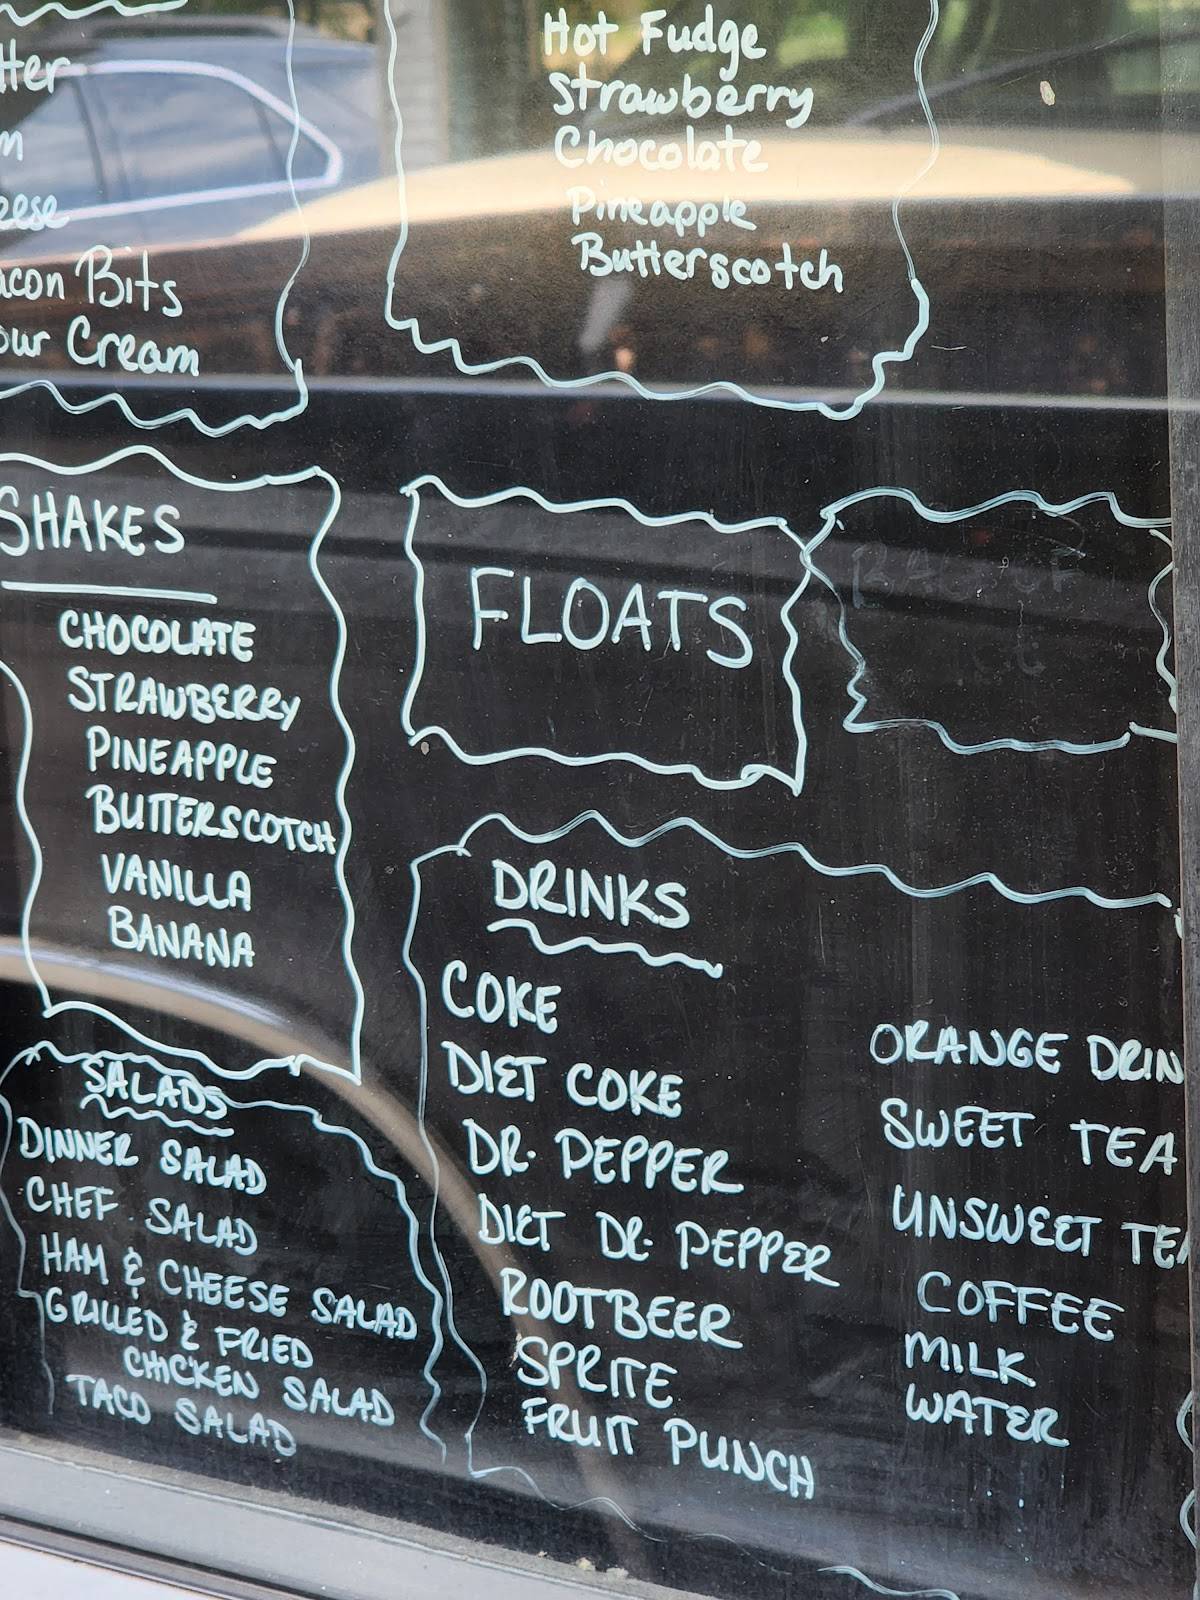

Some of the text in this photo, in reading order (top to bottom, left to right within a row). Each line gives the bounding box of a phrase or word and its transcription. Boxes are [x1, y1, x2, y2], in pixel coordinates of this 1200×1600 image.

[544, 4, 767, 81] Hot Fudge
[549, 62, 814, 129] Strawberry
[554, 124, 769, 173] Chocolate
[566, 184, 757, 237] Pineapple
[75, 244, 183, 318] Bits
[570, 232, 843, 293] Butterscotch
[67, 315, 200, 377] Cream
[0, 485, 186, 557] SHAKES
[59, 608, 256, 662] CHOCOLATE
[471, 567, 754, 669] FLOATS
[67, 665, 302, 733] STRAWBERRY
[86, 725, 278, 789] PINEAPPLE
[85, 783, 338, 856] BUTTERSCOTCH
[101, 853, 252, 912] VANILLA
[491, 859, 691, 929] DRINKS
[107, 904, 256, 968] BANANA
[441, 959, 562, 1034] COKE
[441, 1040, 683, 1119] DIET COKE
[870, 1020, 1070, 1075] ORANGE
[81, 1057, 229, 1121] SALADS
[16, 1116, 267, 1196] DINNER SALAD
[462, 1118, 744, 1195] DR. PEPPER
[881, 1097, 1179, 1177] SWEET TEA
[26, 1176, 258, 1256] CHEF SALAD
[477, 1192, 841, 1288] DIET DR. PEPPER
[892, 1183, 1103, 1258] UNSWEET
[40, 1231, 419, 1341] HAM & CHEESE SALAD
[499, 1266, 744, 1350] ROOTBEER
[916, 1270, 1126, 1342] COFFEE
[45, 1286, 315, 1369] GRILLED & FRIED
[904, 1331, 1037, 1388] MILK
[123, 1344, 396, 1427] CHICKEN SALAD
[516, 1335, 678, 1409] SPRITE
[65, 1374, 298, 1457] TACO SALAD
[521, 1397, 816, 1500] FRUIT PUNCH
[905, 1383, 1071, 1447] WATER
